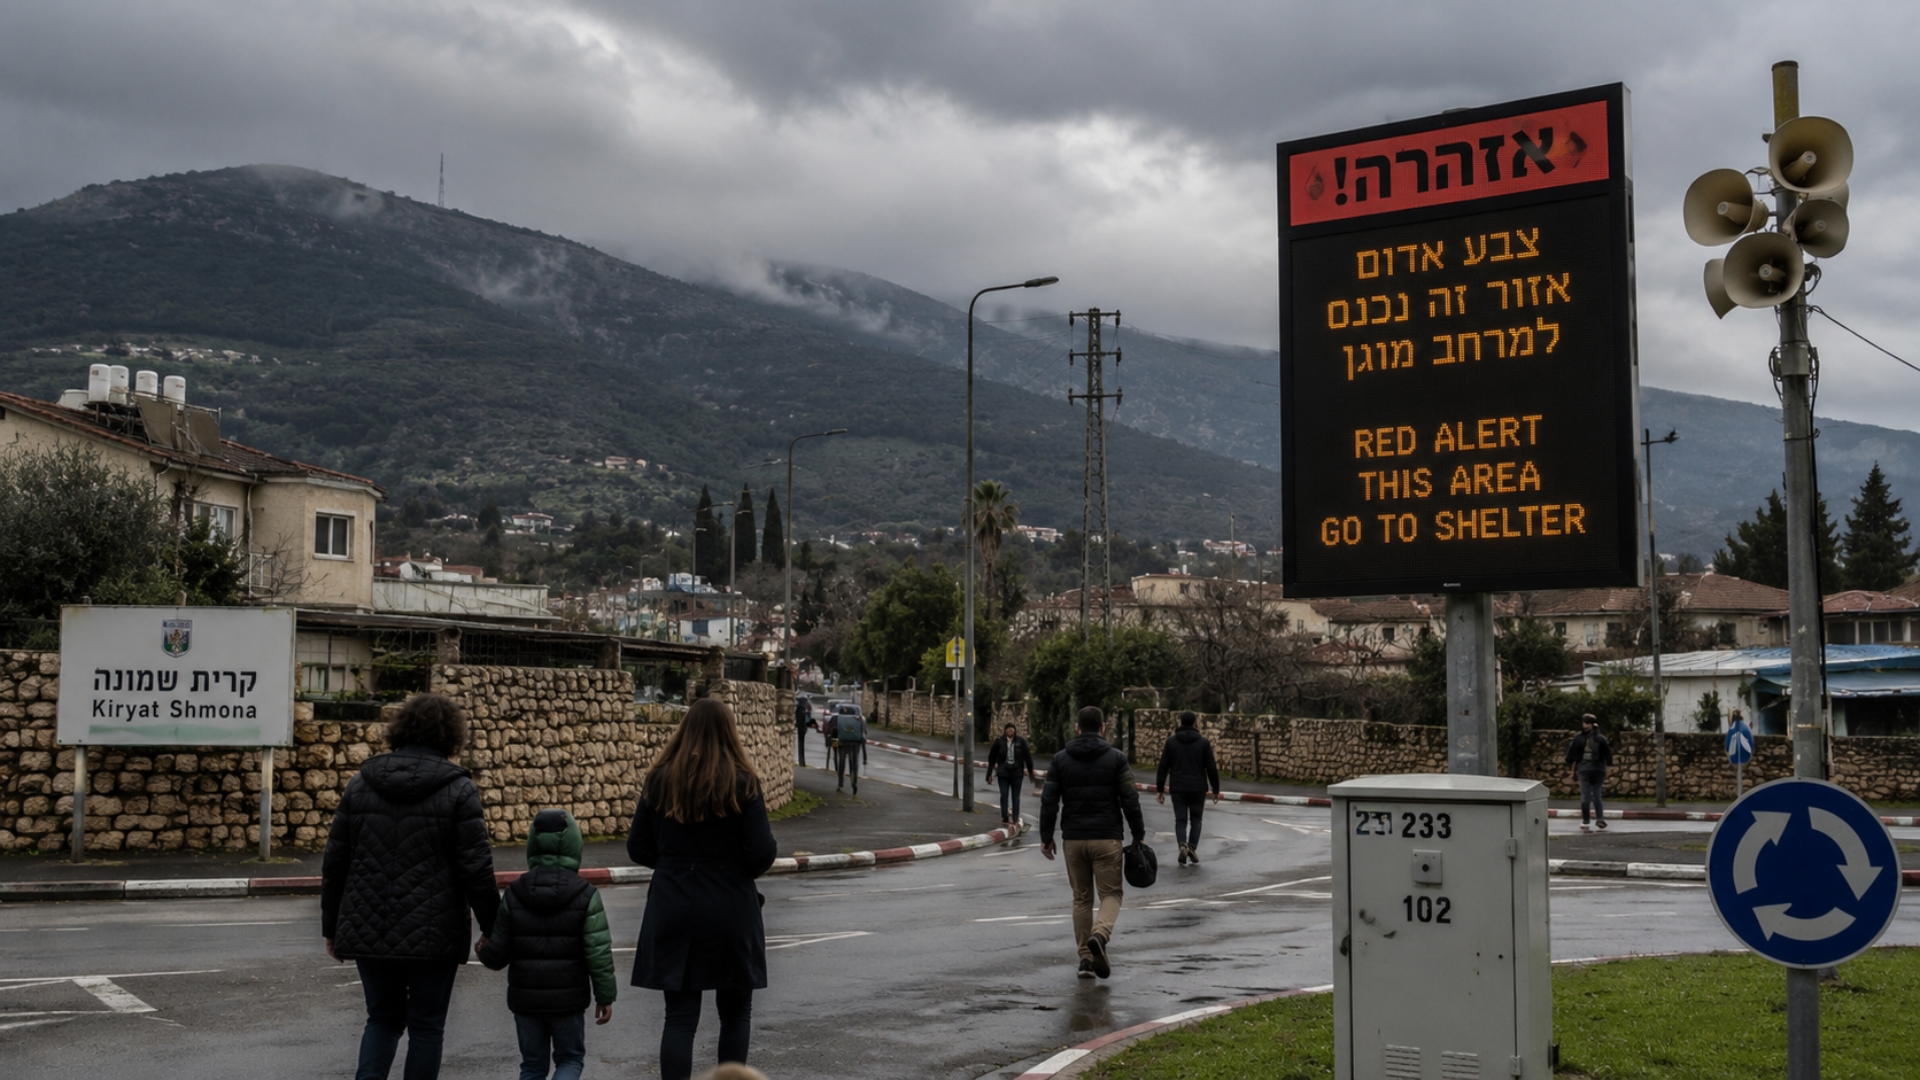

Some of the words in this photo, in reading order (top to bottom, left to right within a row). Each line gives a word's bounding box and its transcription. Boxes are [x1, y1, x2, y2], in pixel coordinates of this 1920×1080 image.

[1334, 127, 1555, 206] אזהרה!
[1357, 240, 1444, 279] אדום
[1463, 227, 1539, 265] צבע
[1429, 284, 1467, 317] זה
[1487, 272, 1571, 309] אזור
[1328, 292, 1409, 329] נכנס
[1433, 317, 1559, 364] למרחב
[1343, 339, 1414, 380] מוגן
[1355, 426, 1417, 458] RED
[1435, 415, 1542, 453] ALERT
[1359, 467, 1433, 500] THIS
[1451, 461, 1540, 495] AREA
[1321, 516, 1362, 546] GO
[1378, 513, 1417, 543] TO
[1435, 504, 1586, 541] SHELTER
[94, 669, 178, 692] שמונה
[190, 670, 257, 698] קרית
[92, 699, 159, 722] Kiryat
[170, 700, 257, 719] Shmona
[1402, 812, 1451, 839] 233
[1403, 895, 1451, 924] 102
